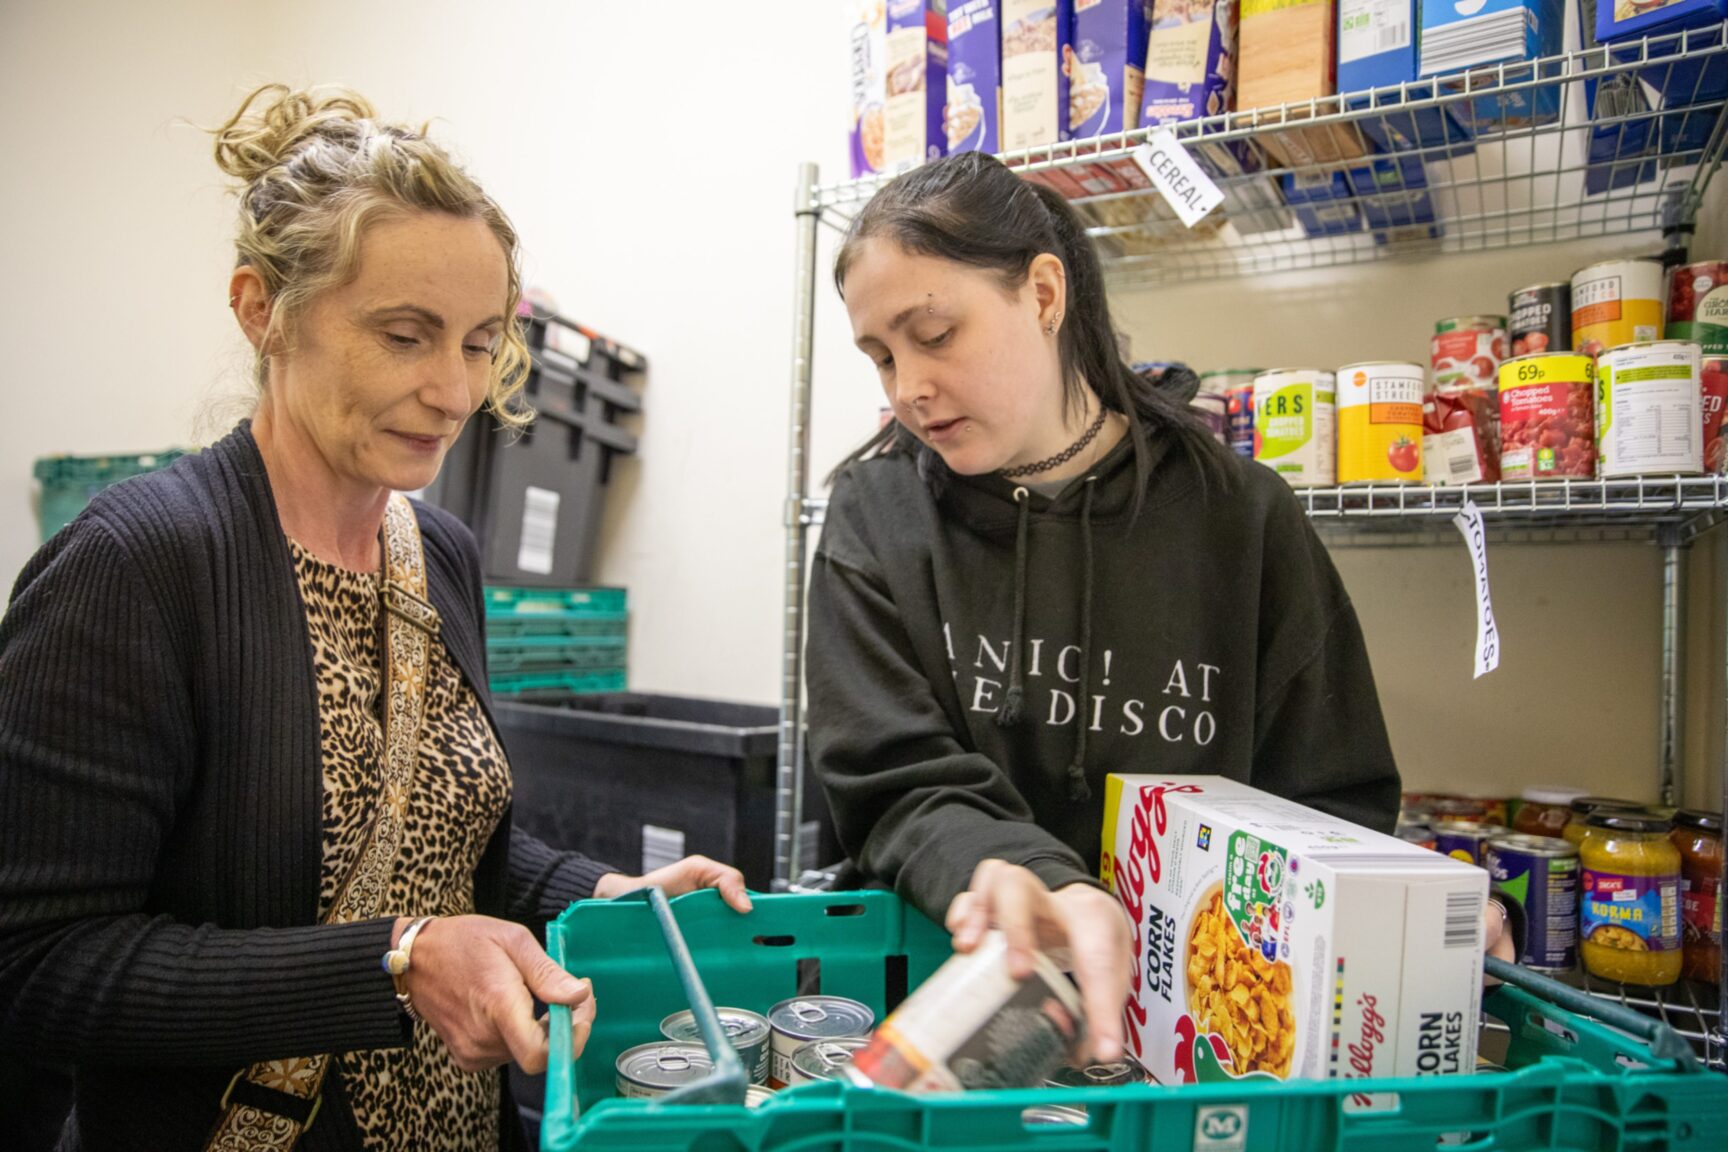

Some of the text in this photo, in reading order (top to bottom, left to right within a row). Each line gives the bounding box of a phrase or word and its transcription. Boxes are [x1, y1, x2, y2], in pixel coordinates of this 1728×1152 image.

[1149, 150, 1203, 211] CEREAL
[1518, 364, 1545, 380] 69p
[1257, 394, 1304, 416] ERS
[1468, 513, 1495, 662] TOMATOES
[1161, 659, 1220, 702] AT
[1046, 689, 1216, 745] DISCO
[1227, 836, 1246, 911] free
[1243, 861, 1255, 901] day
[1592, 901, 1643, 922] KORMA
[1147, 904, 1164, 992] CORN
[1161, 915, 1176, 1003] FLAKES
[1417, 1012, 1443, 1076] ORN
[1443, 1011, 1463, 1074] LAKES
